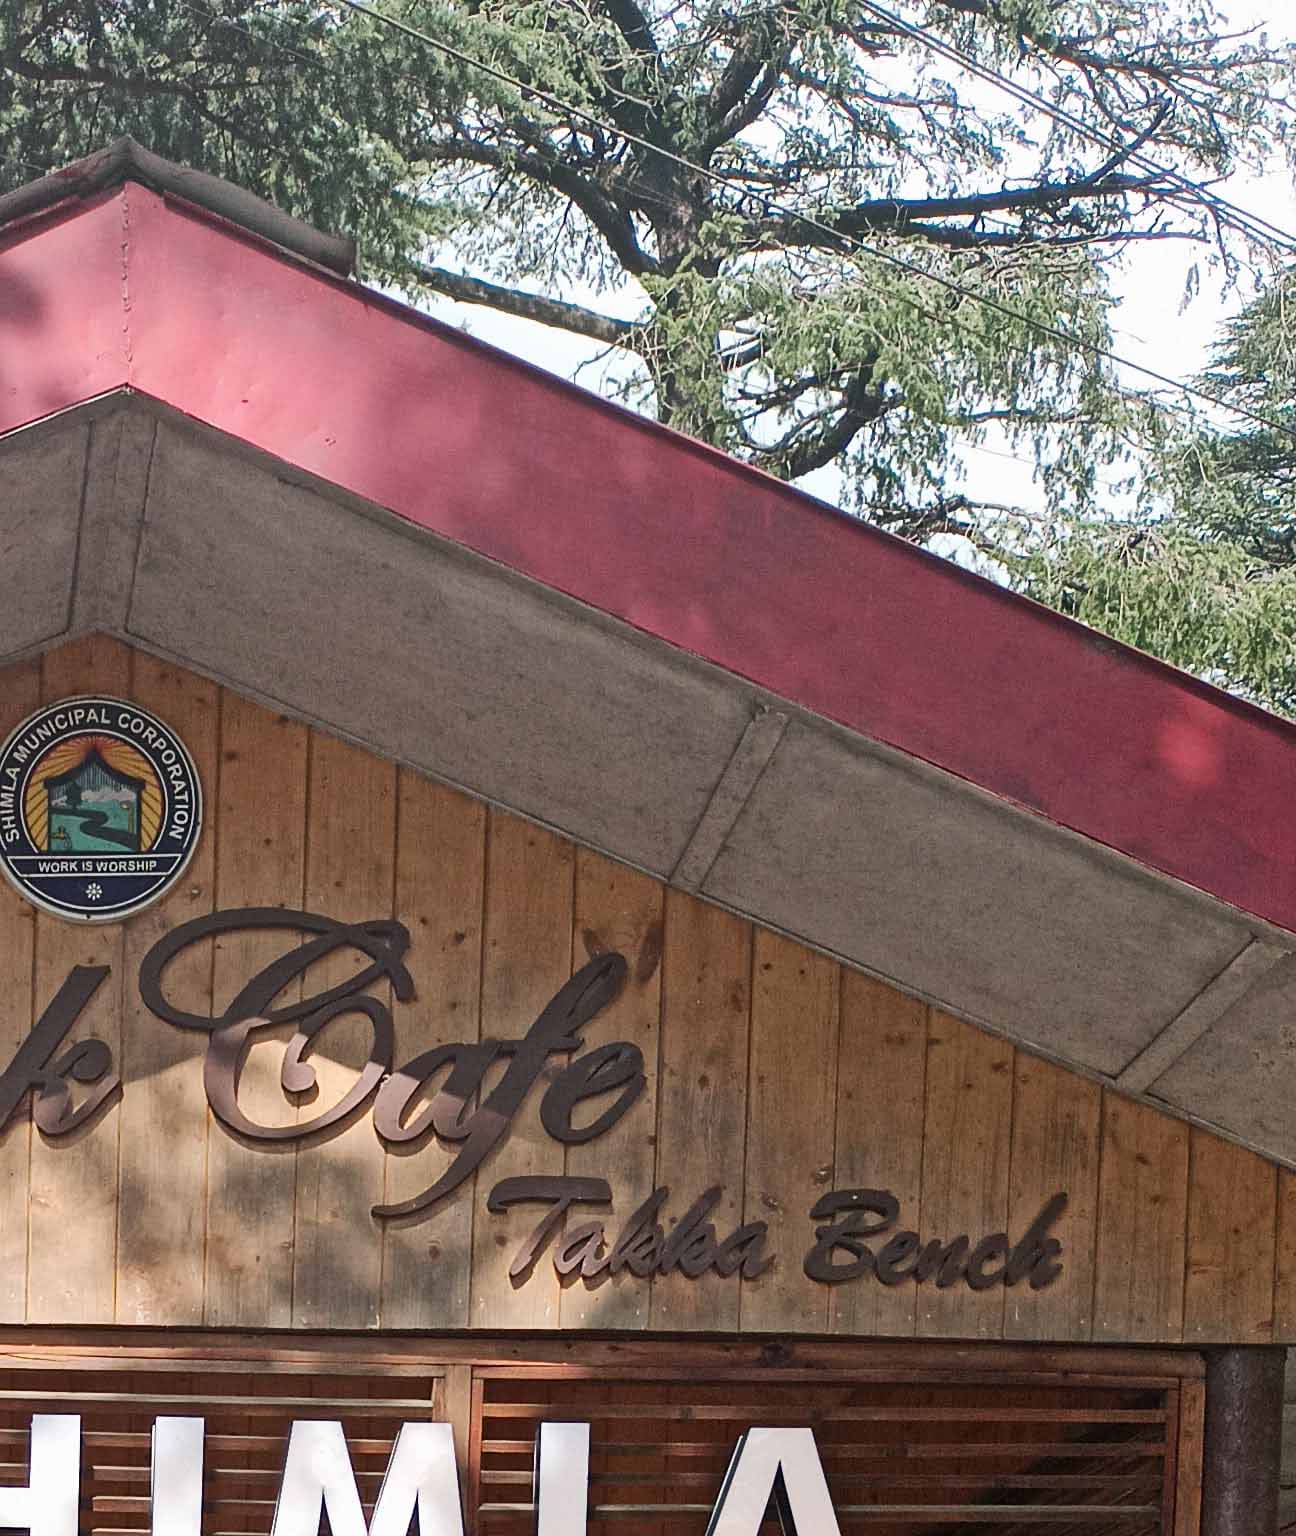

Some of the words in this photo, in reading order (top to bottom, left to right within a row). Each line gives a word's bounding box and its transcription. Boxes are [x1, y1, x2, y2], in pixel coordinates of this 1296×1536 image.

[0, 766, 21, 844] SHIMLA
[12, 708, 111, 764] MUNICIPAL
[118, 712, 189, 841] CORPORATION
[38, 861, 78, 873] WORK
[82, 861, 93, 872] IS
[96, 860, 157, 872] WORSHIP
[138, 906, 646, 1218] Cafe
[487, 1175, 776, 1283] Takka
[804, 1188, 1069, 1290] Bench
